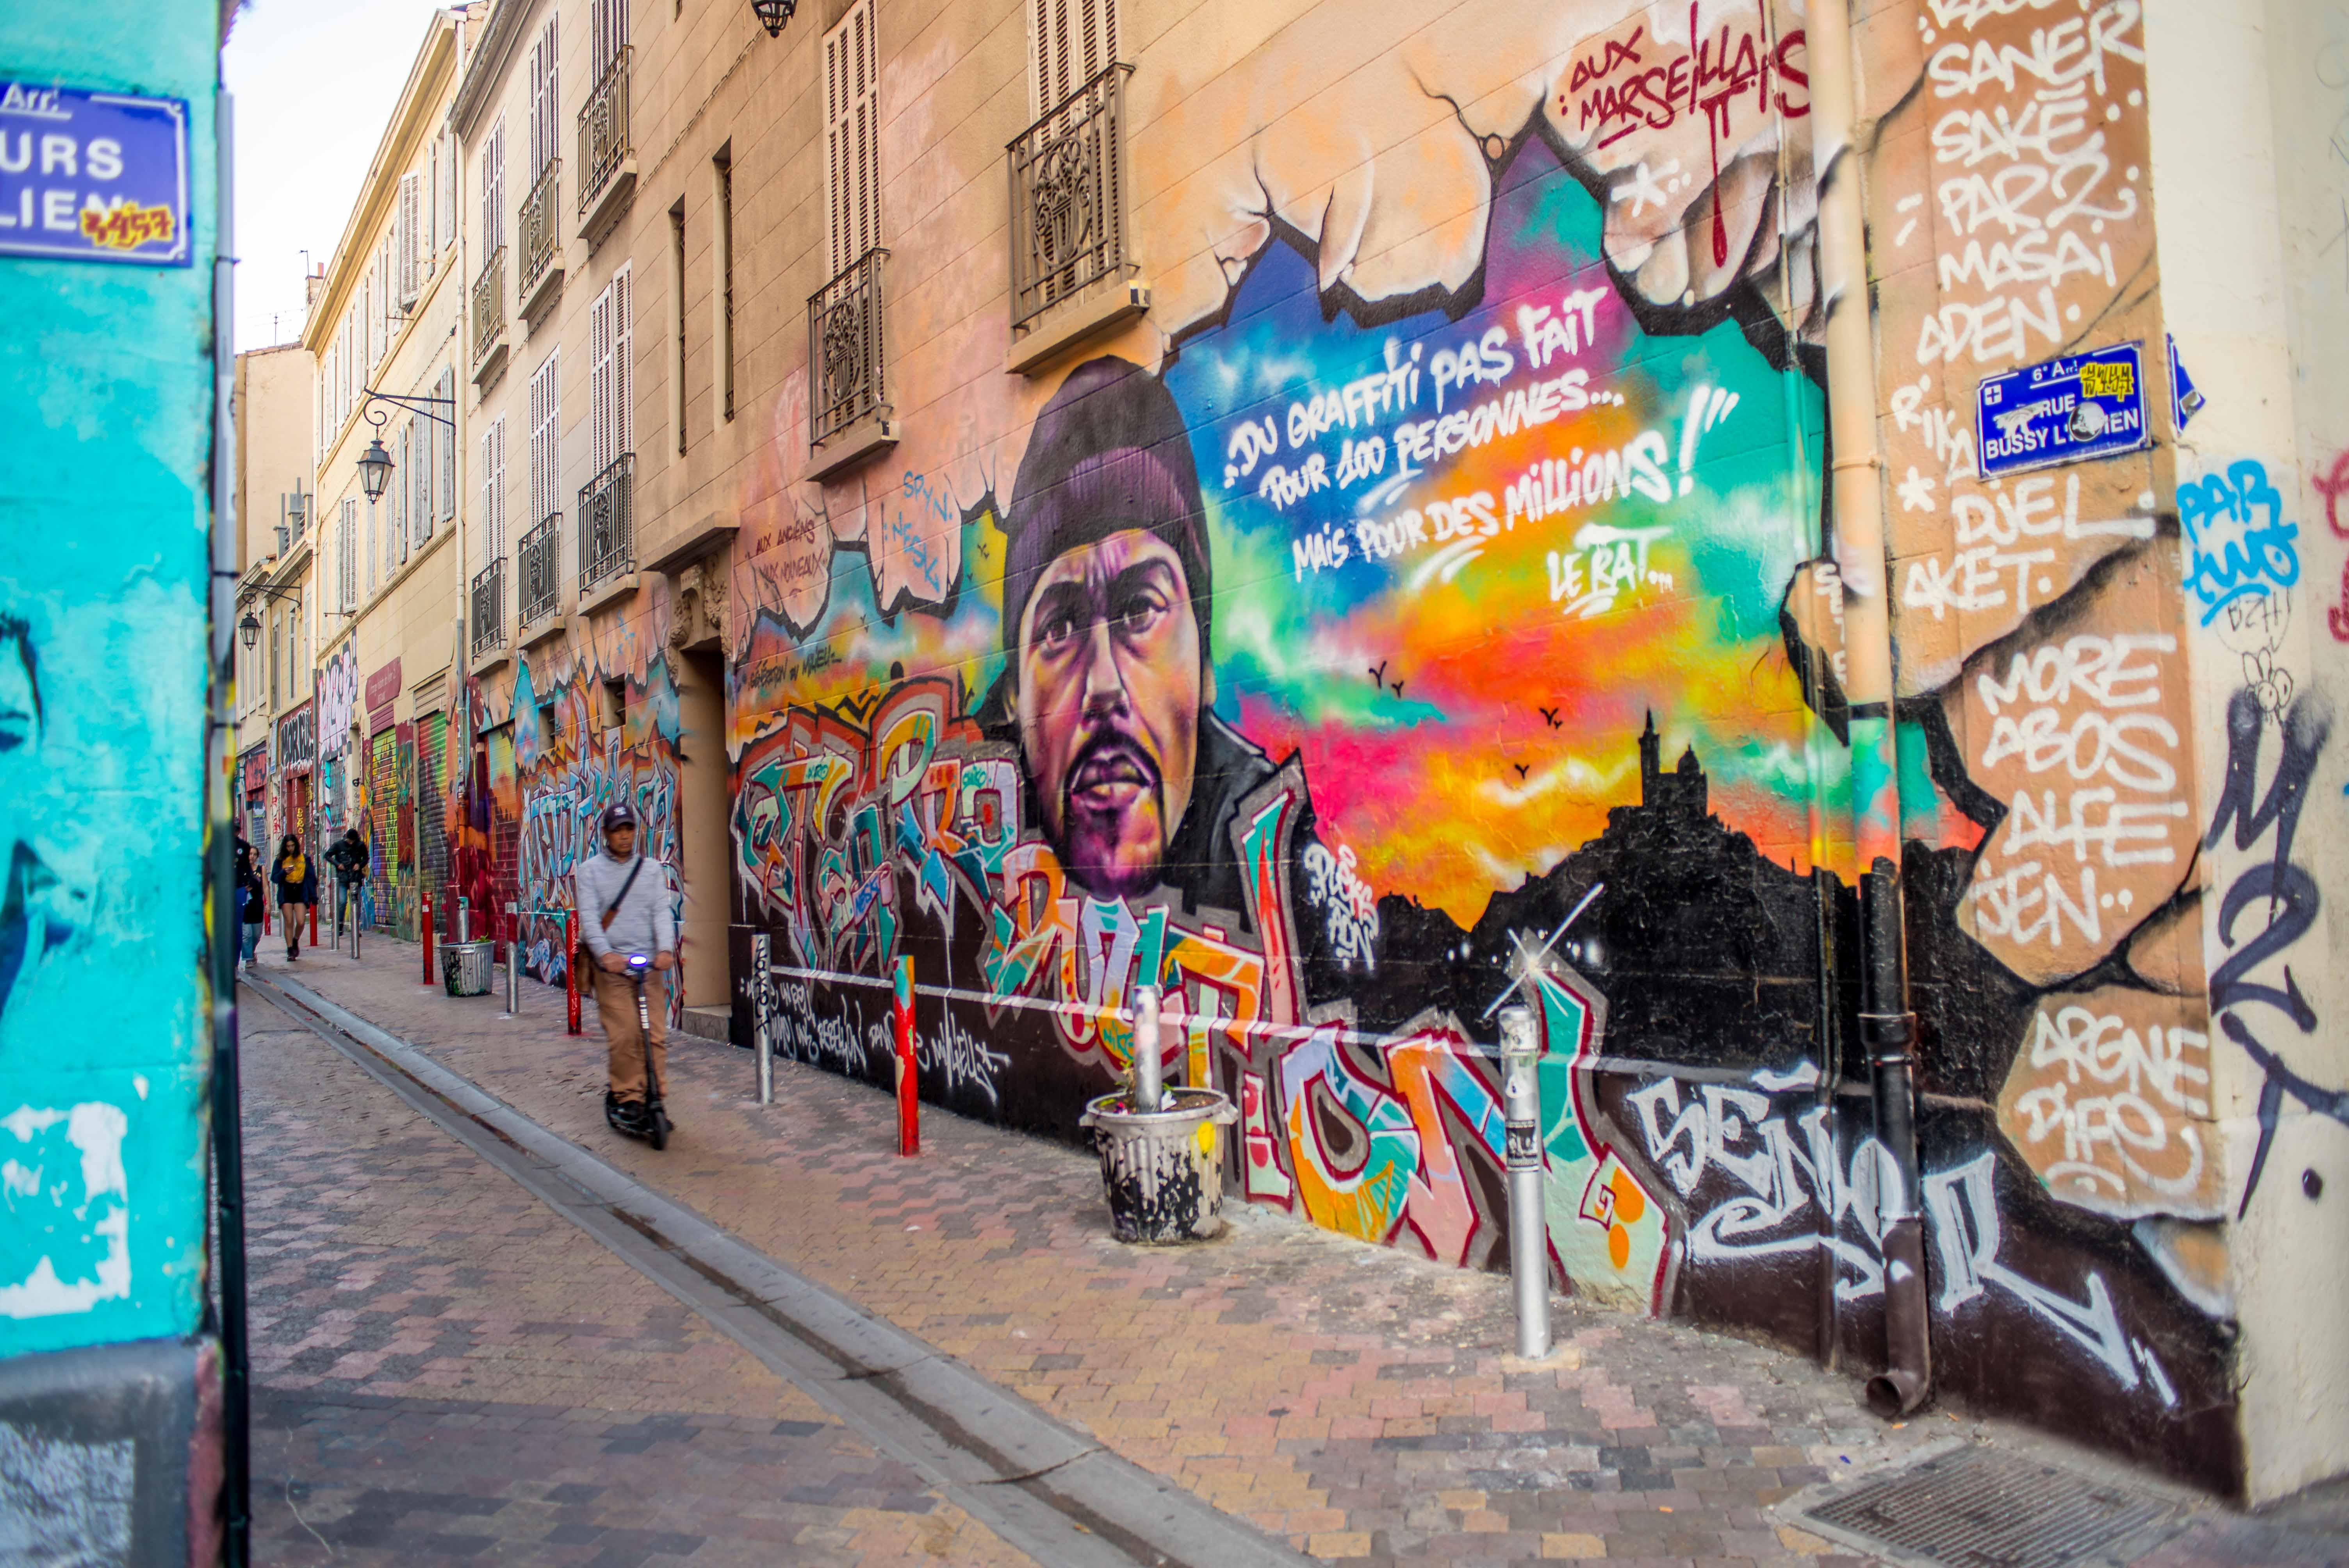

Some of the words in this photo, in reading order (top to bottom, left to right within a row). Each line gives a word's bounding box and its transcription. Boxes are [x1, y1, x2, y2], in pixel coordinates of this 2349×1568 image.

[1570, 25, 1643, 93] AUX
[1429, 326, 1514, 414] PAS
[2039, 394, 2075, 419] RUE
[1260, 453, 1331, 510] POUR
[1335, 435, 1386, 490] 100
[1986, 428, 2049, 459] BUSSY
[1355, 508, 1428, 563] POUR
[1424, 490, 1499, 540] DES
[1545, 550, 1582, 601] LE
[1977, 634, 2178, 715] MORE
